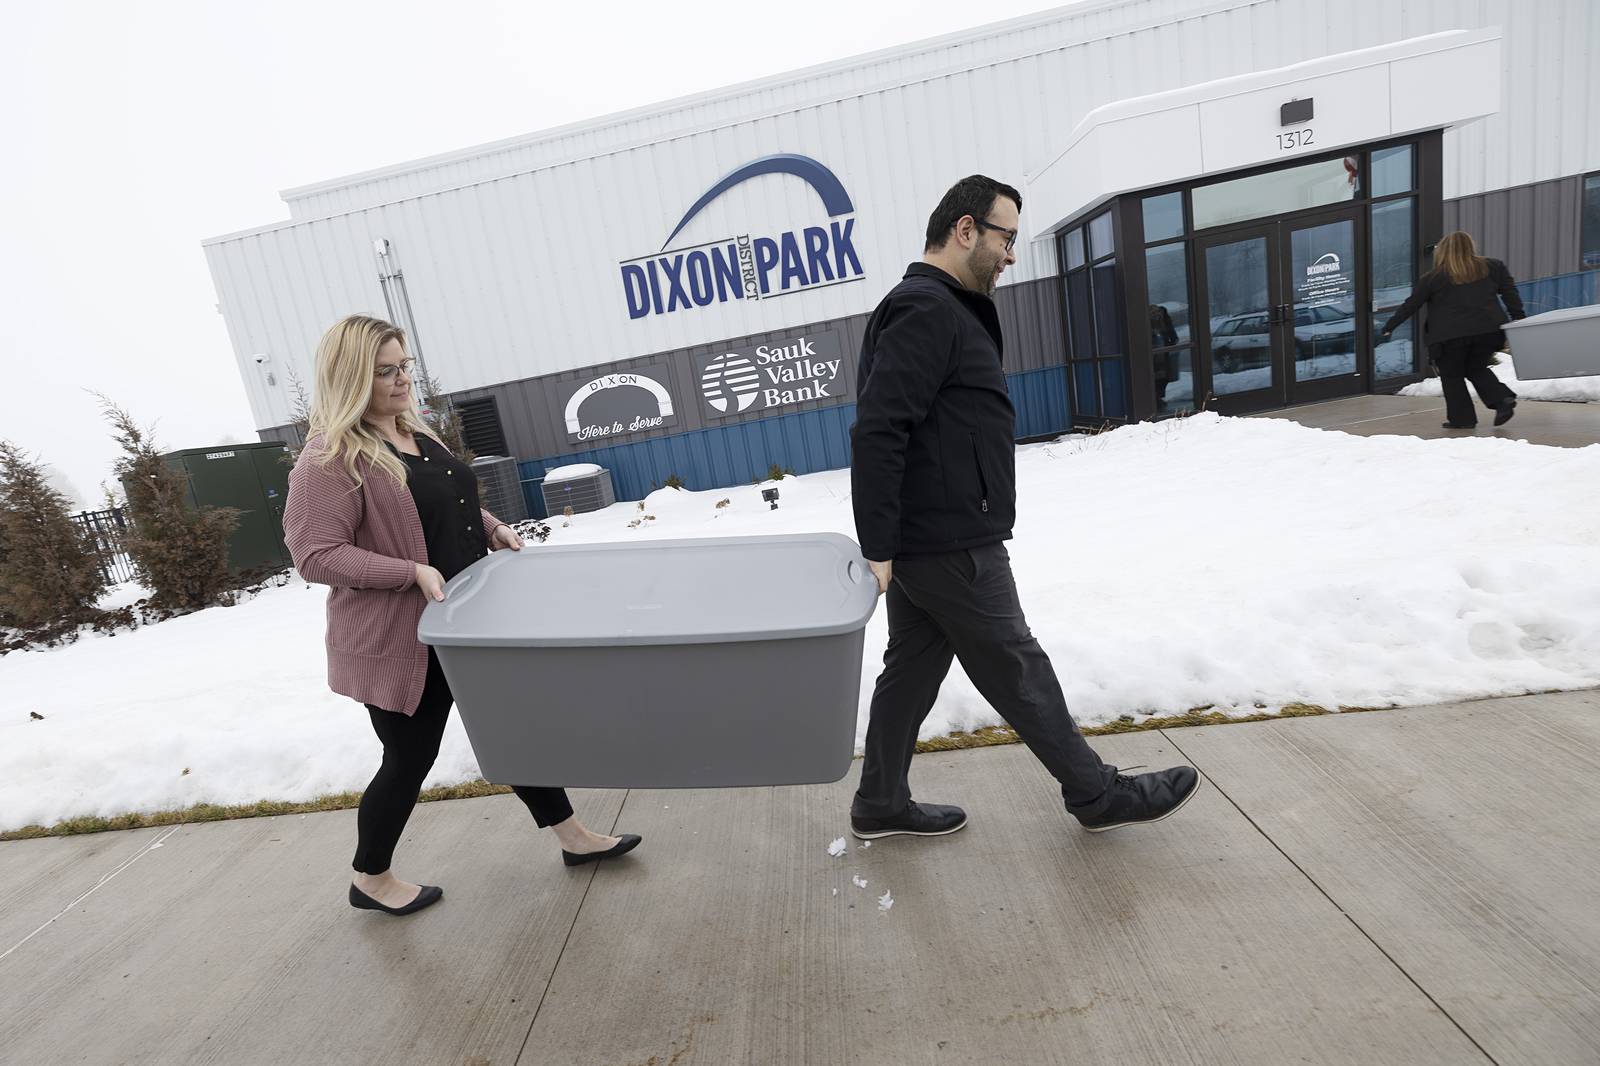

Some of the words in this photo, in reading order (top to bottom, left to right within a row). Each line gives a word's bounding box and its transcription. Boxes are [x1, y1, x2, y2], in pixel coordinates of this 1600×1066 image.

[1275, 128, 1314, 150] 1312
[620, 243, 744, 320] DIXON
[753, 218, 864, 294] PARK
[736, 233, 760, 301] DISTRICT
[755, 337, 816, 366] Sauk
[589, 374, 638, 392] DIXON
[764, 358, 841, 385] Valley
[762, 380, 831, 408] Bank
[577, 423, 610, 440] Here
[611, 420, 624, 433] to
[628, 415, 664, 432] Serve
